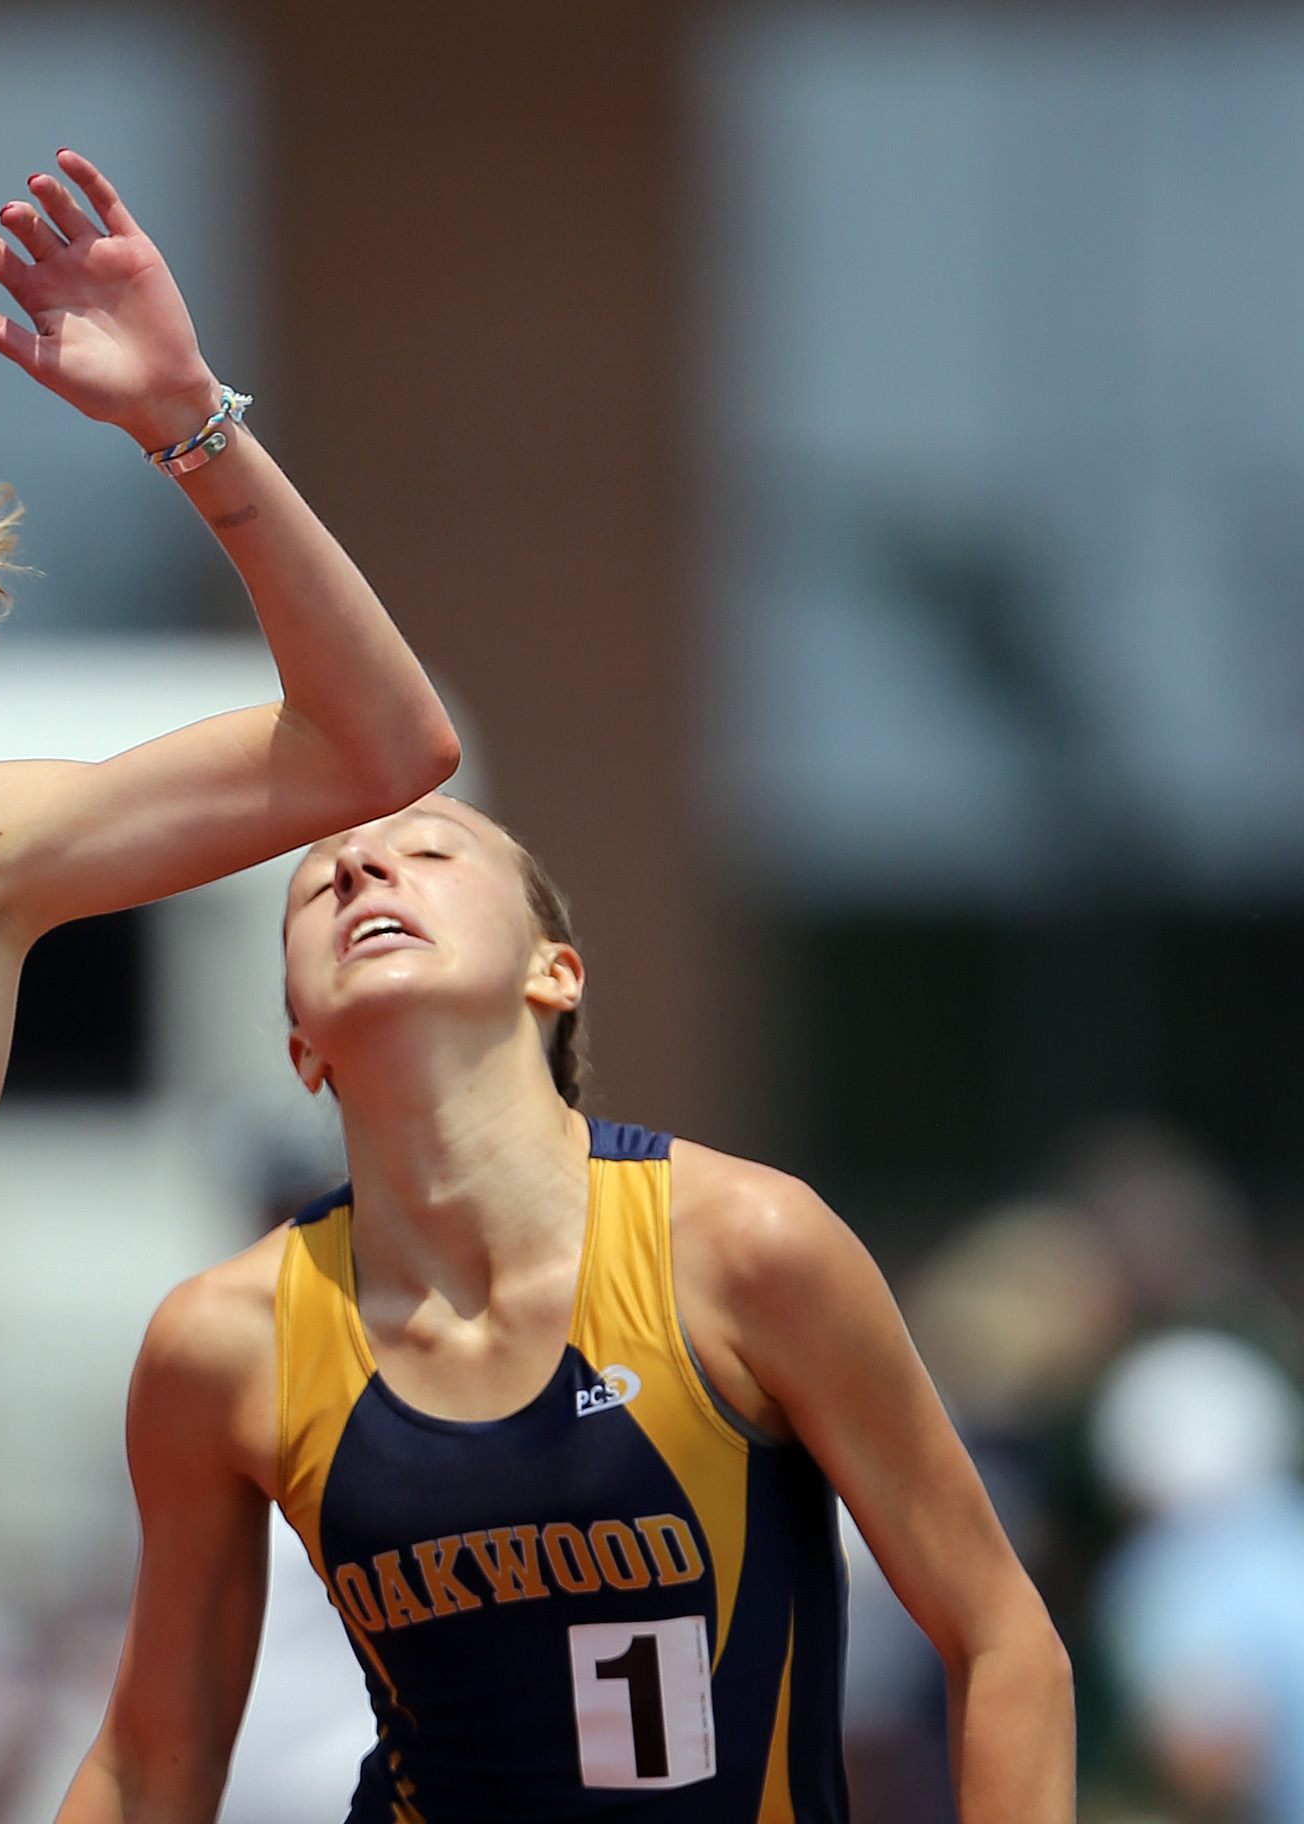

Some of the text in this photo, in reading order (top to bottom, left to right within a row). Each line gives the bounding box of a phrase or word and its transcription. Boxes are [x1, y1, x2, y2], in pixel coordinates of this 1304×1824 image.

[576, 1381, 621, 1412] PCS
[336, 1513, 705, 1632] OAKWOOD
[595, 1634, 669, 1778] 1
